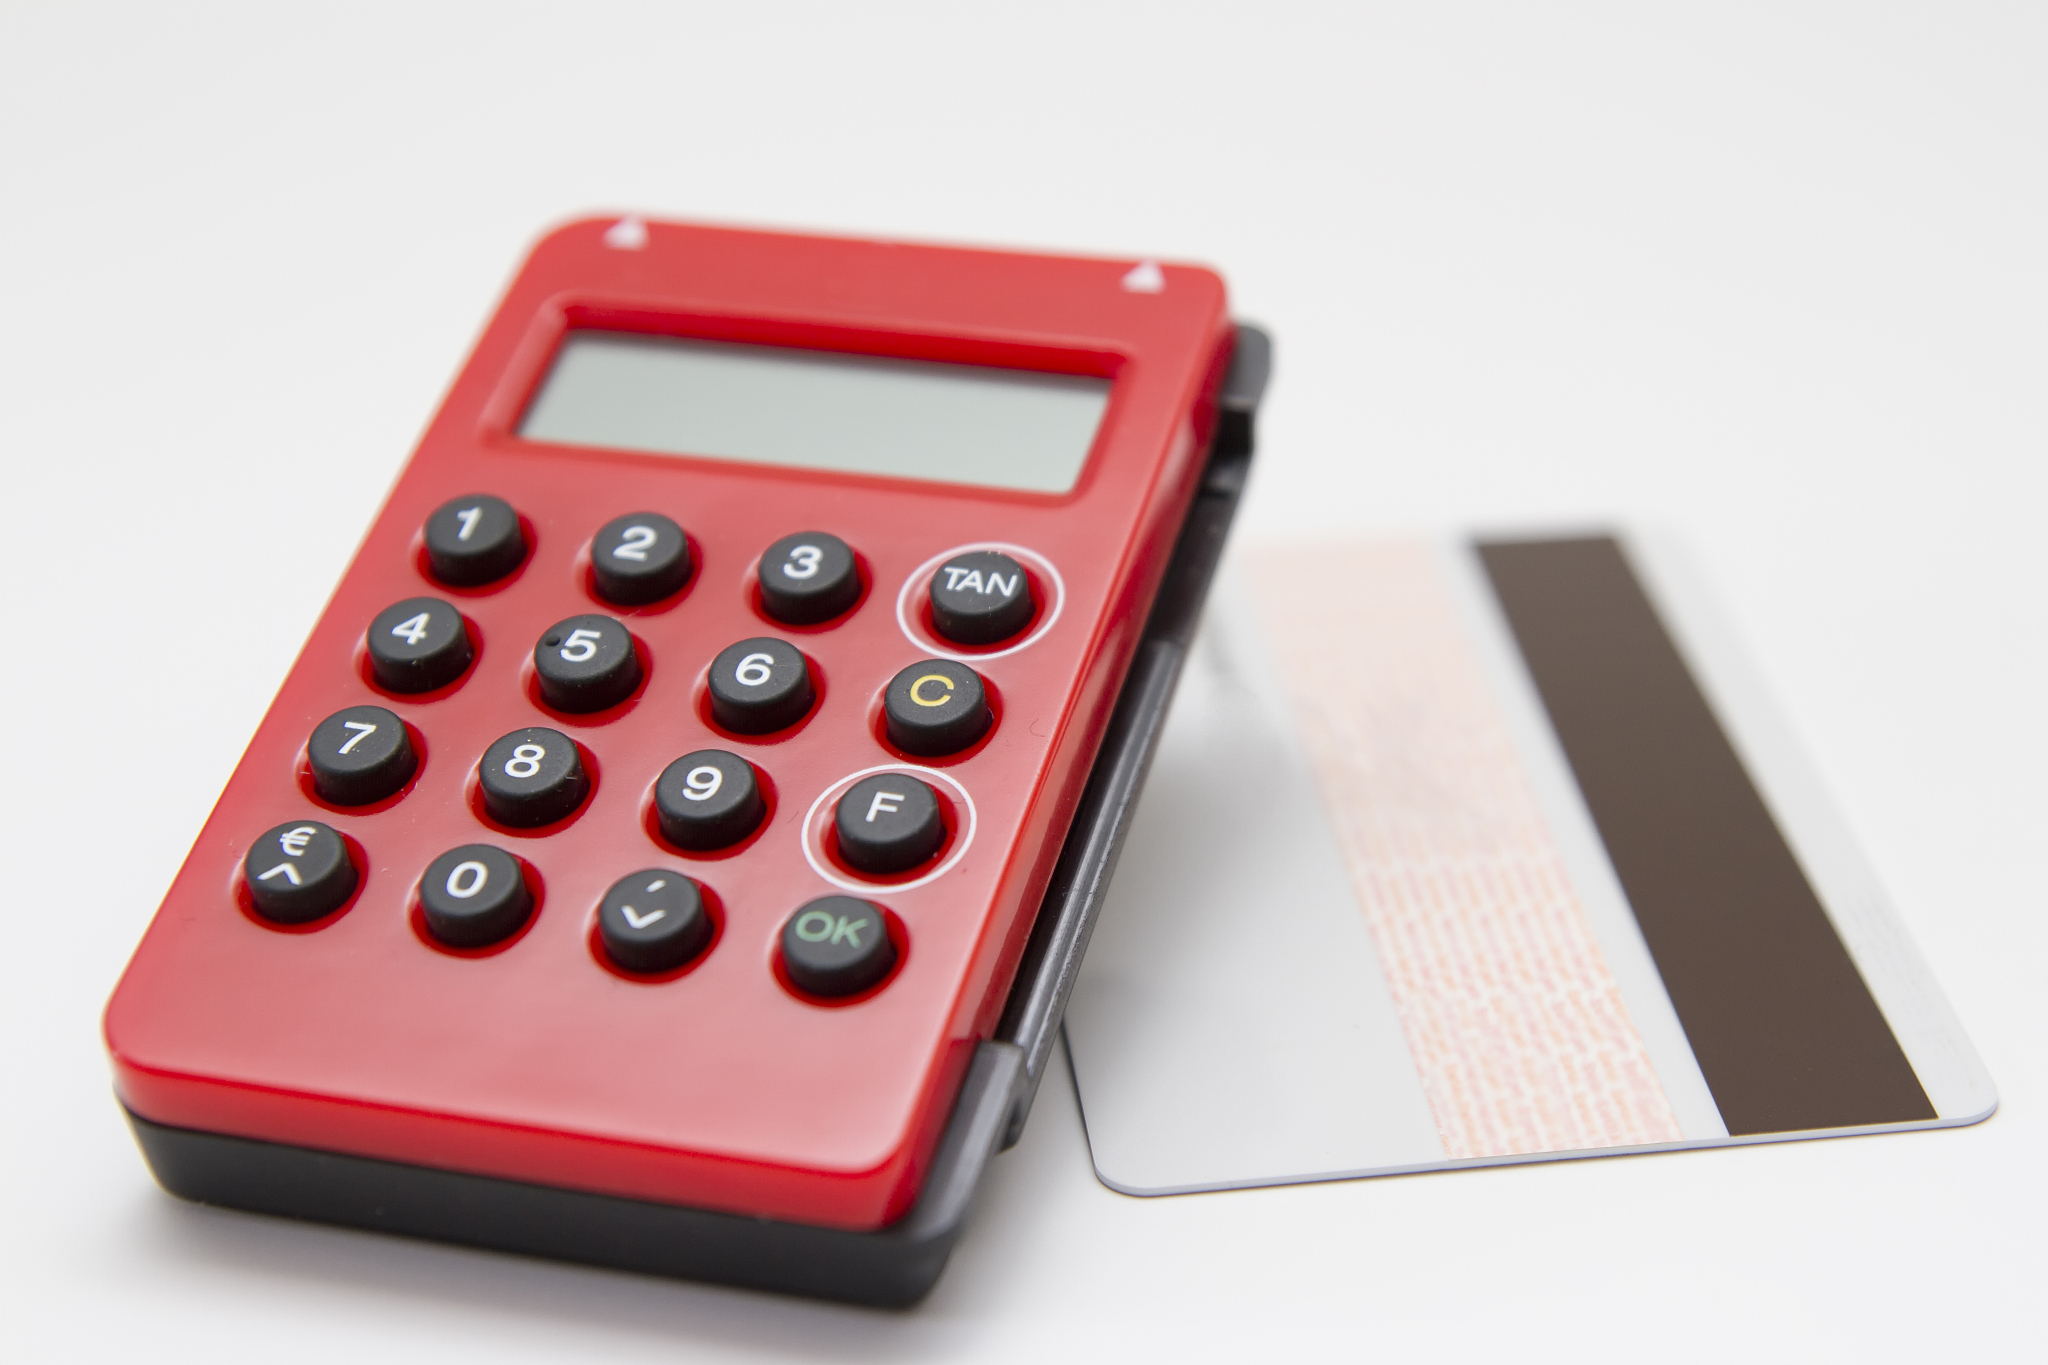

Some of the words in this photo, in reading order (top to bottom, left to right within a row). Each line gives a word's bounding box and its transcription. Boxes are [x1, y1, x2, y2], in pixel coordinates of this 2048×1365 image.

[456, 507, 482, 541] 1
[612, 525, 658, 562] 2
[782, 545, 823, 579] 3
[944, 566, 1018, 598] TAN
[391, 612, 430, 645] 4
[560, 628, 601, 663] 5
[735, 652, 775, 686] 6
[911, 674, 955, 706] C
[338, 721, 377, 755] 7
[504, 744, 546, 778] 8
[682, 765, 723, 800] 9
[866, 791, 905, 823] F
[794, 911, 867, 948] OK
